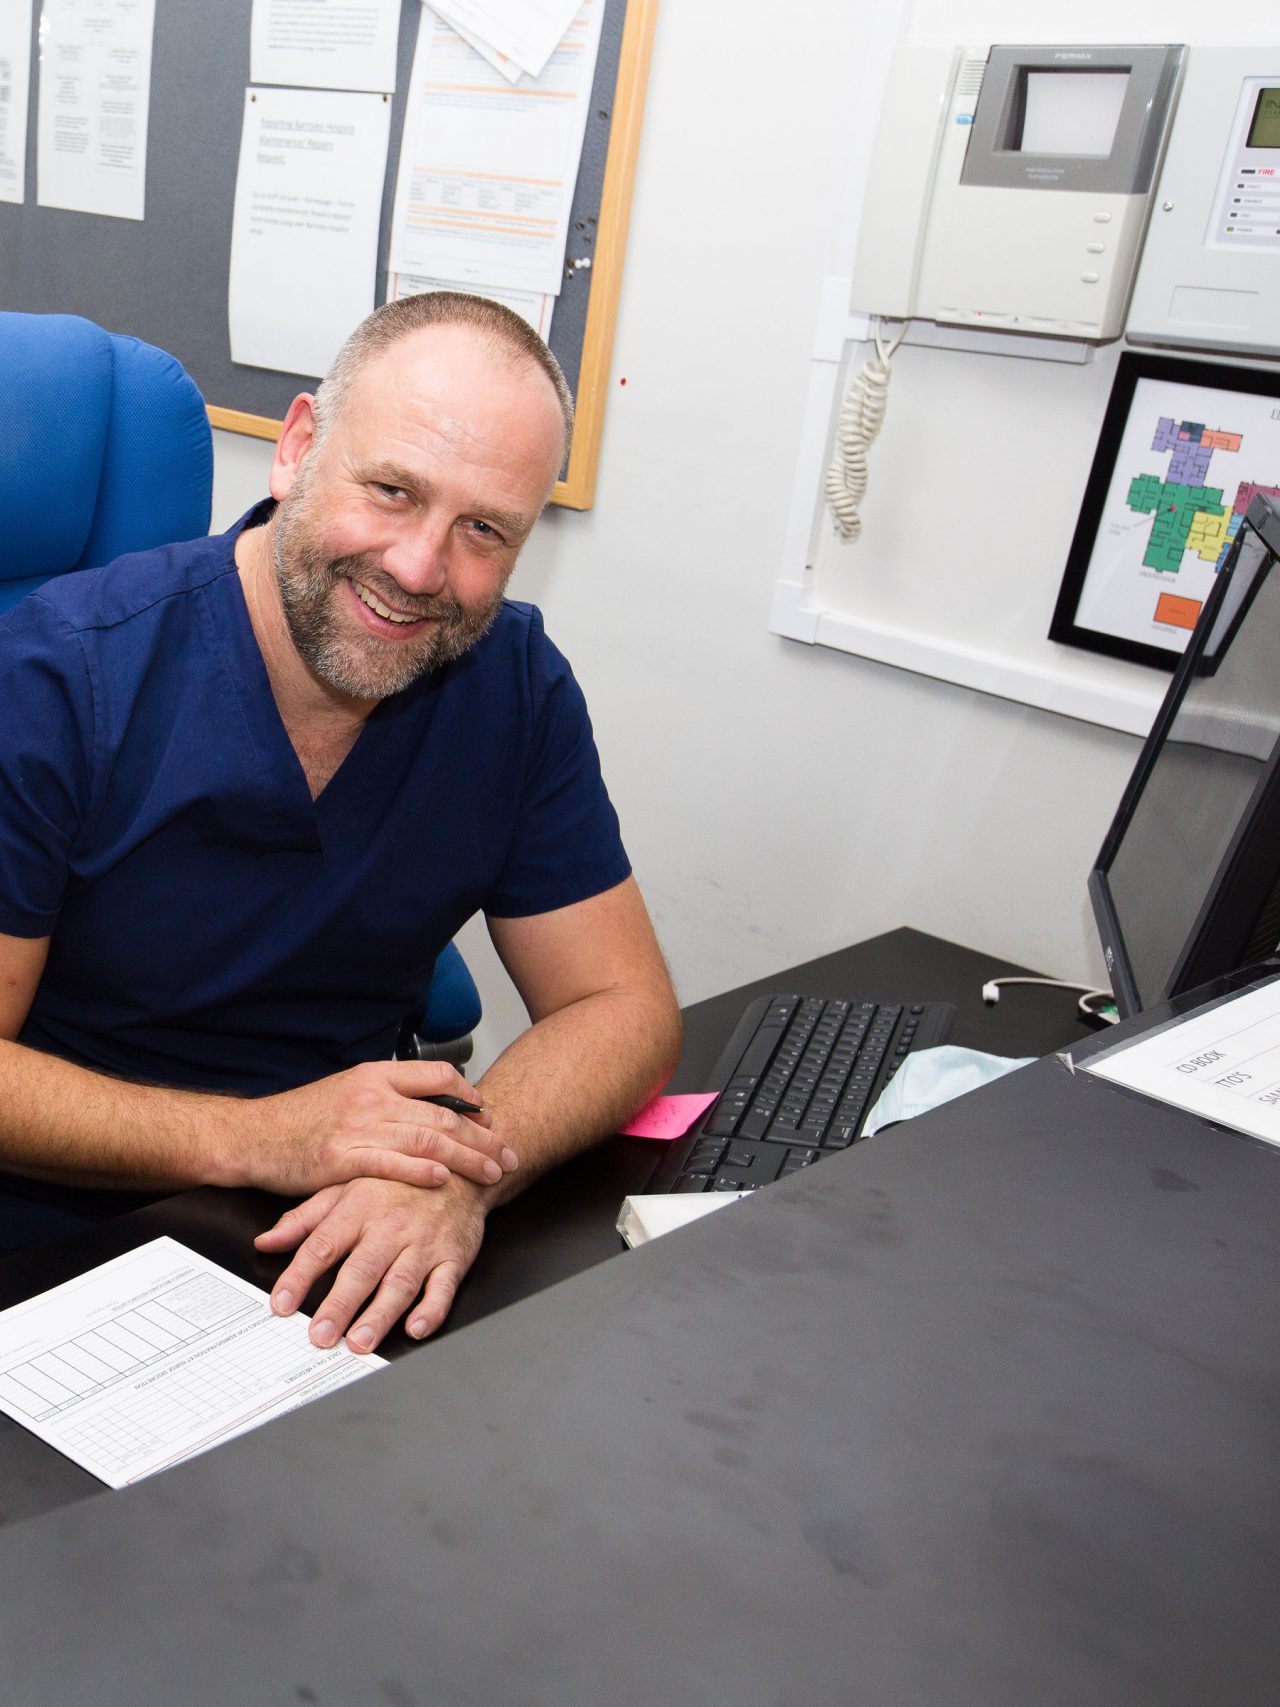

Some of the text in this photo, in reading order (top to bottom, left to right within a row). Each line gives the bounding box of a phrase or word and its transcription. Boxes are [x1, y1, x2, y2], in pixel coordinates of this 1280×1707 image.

[1258, 168, 1276, 176] FIRE
[1176, 1049, 1227, 1074] CD BOOK
[237, 1326, 248, 1335] FOR
[193, 1333, 237, 1358] ADMINISTRATION
[166, 1359, 186, 1373] NURSE
[283, 1365, 313, 1385] MEDICINES
[133, 1369, 167, 1390] DISCRETION
